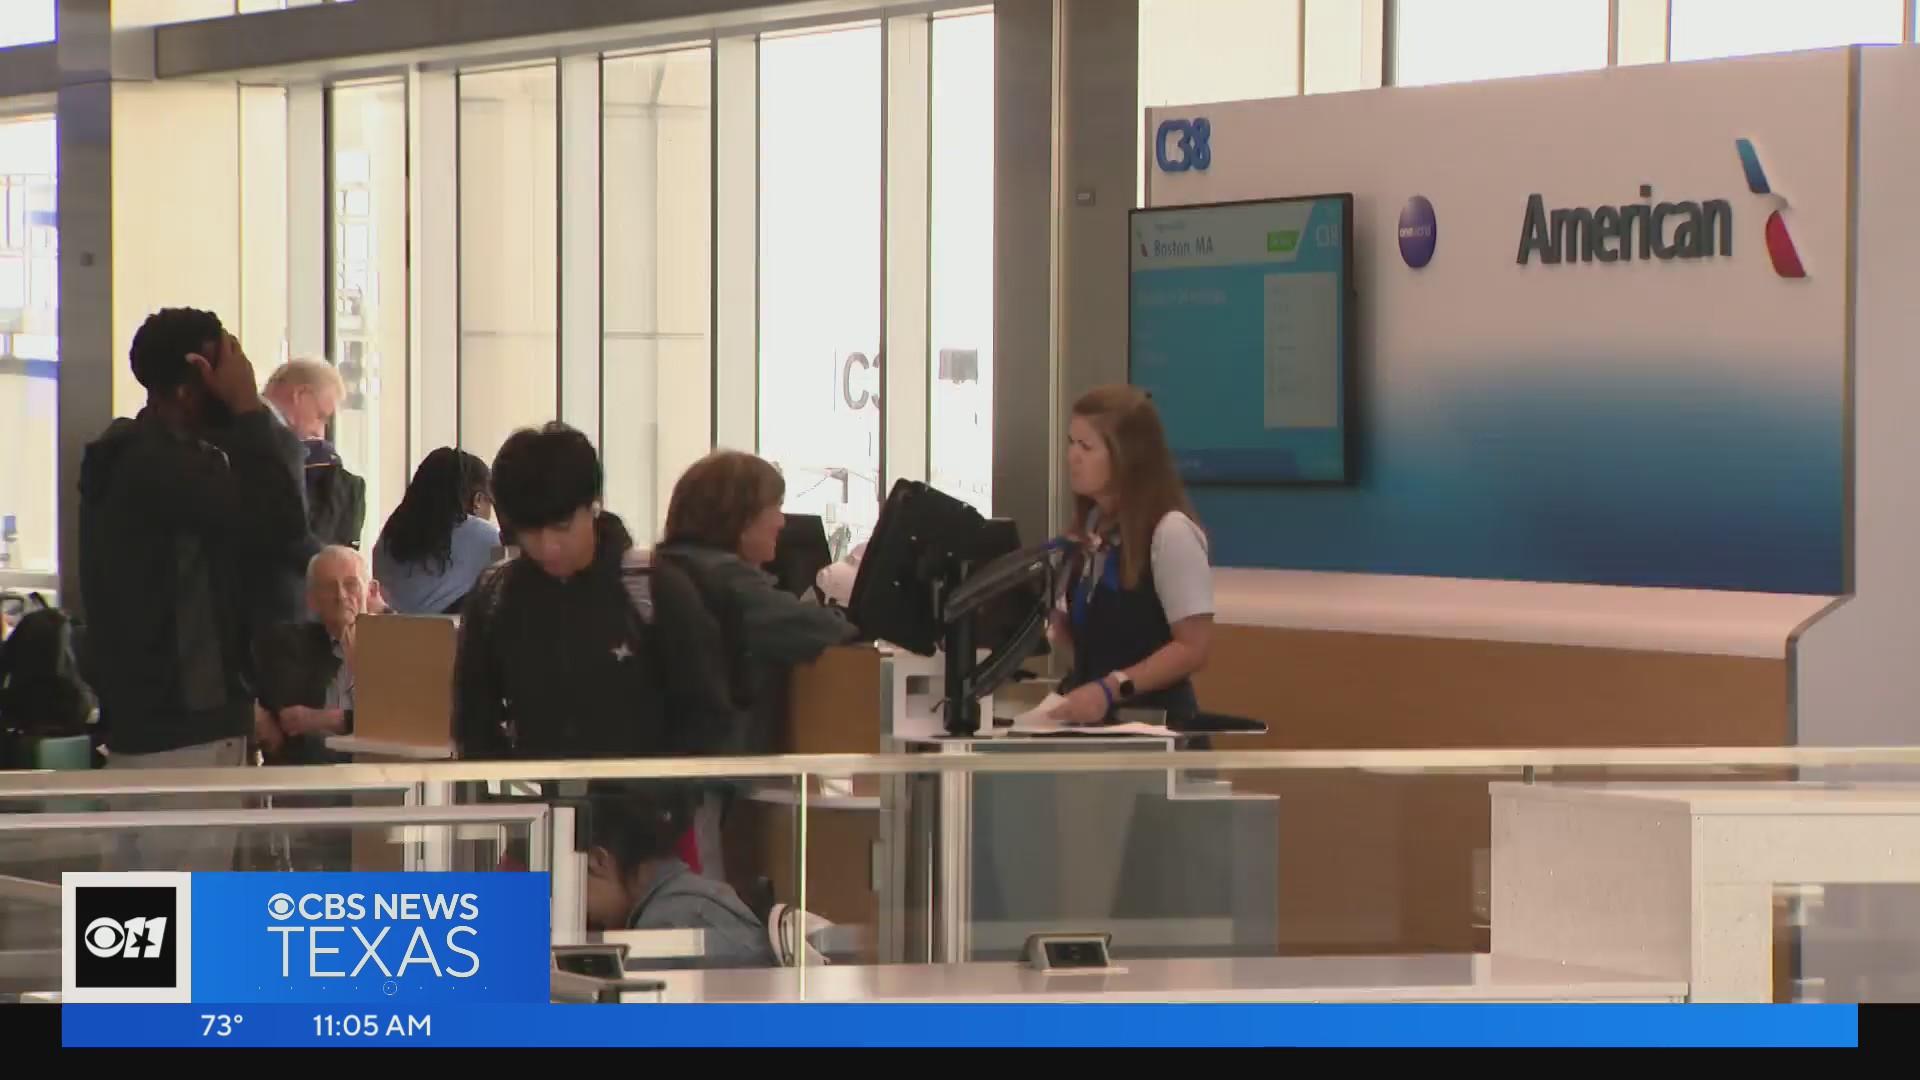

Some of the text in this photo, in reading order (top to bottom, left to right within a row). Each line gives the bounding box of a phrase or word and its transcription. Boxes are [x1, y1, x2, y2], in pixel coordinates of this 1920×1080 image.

[1156, 118, 1211, 171] C38
[1195, 236, 1214, 256] MA
[1516, 184, 1732, 265] American
